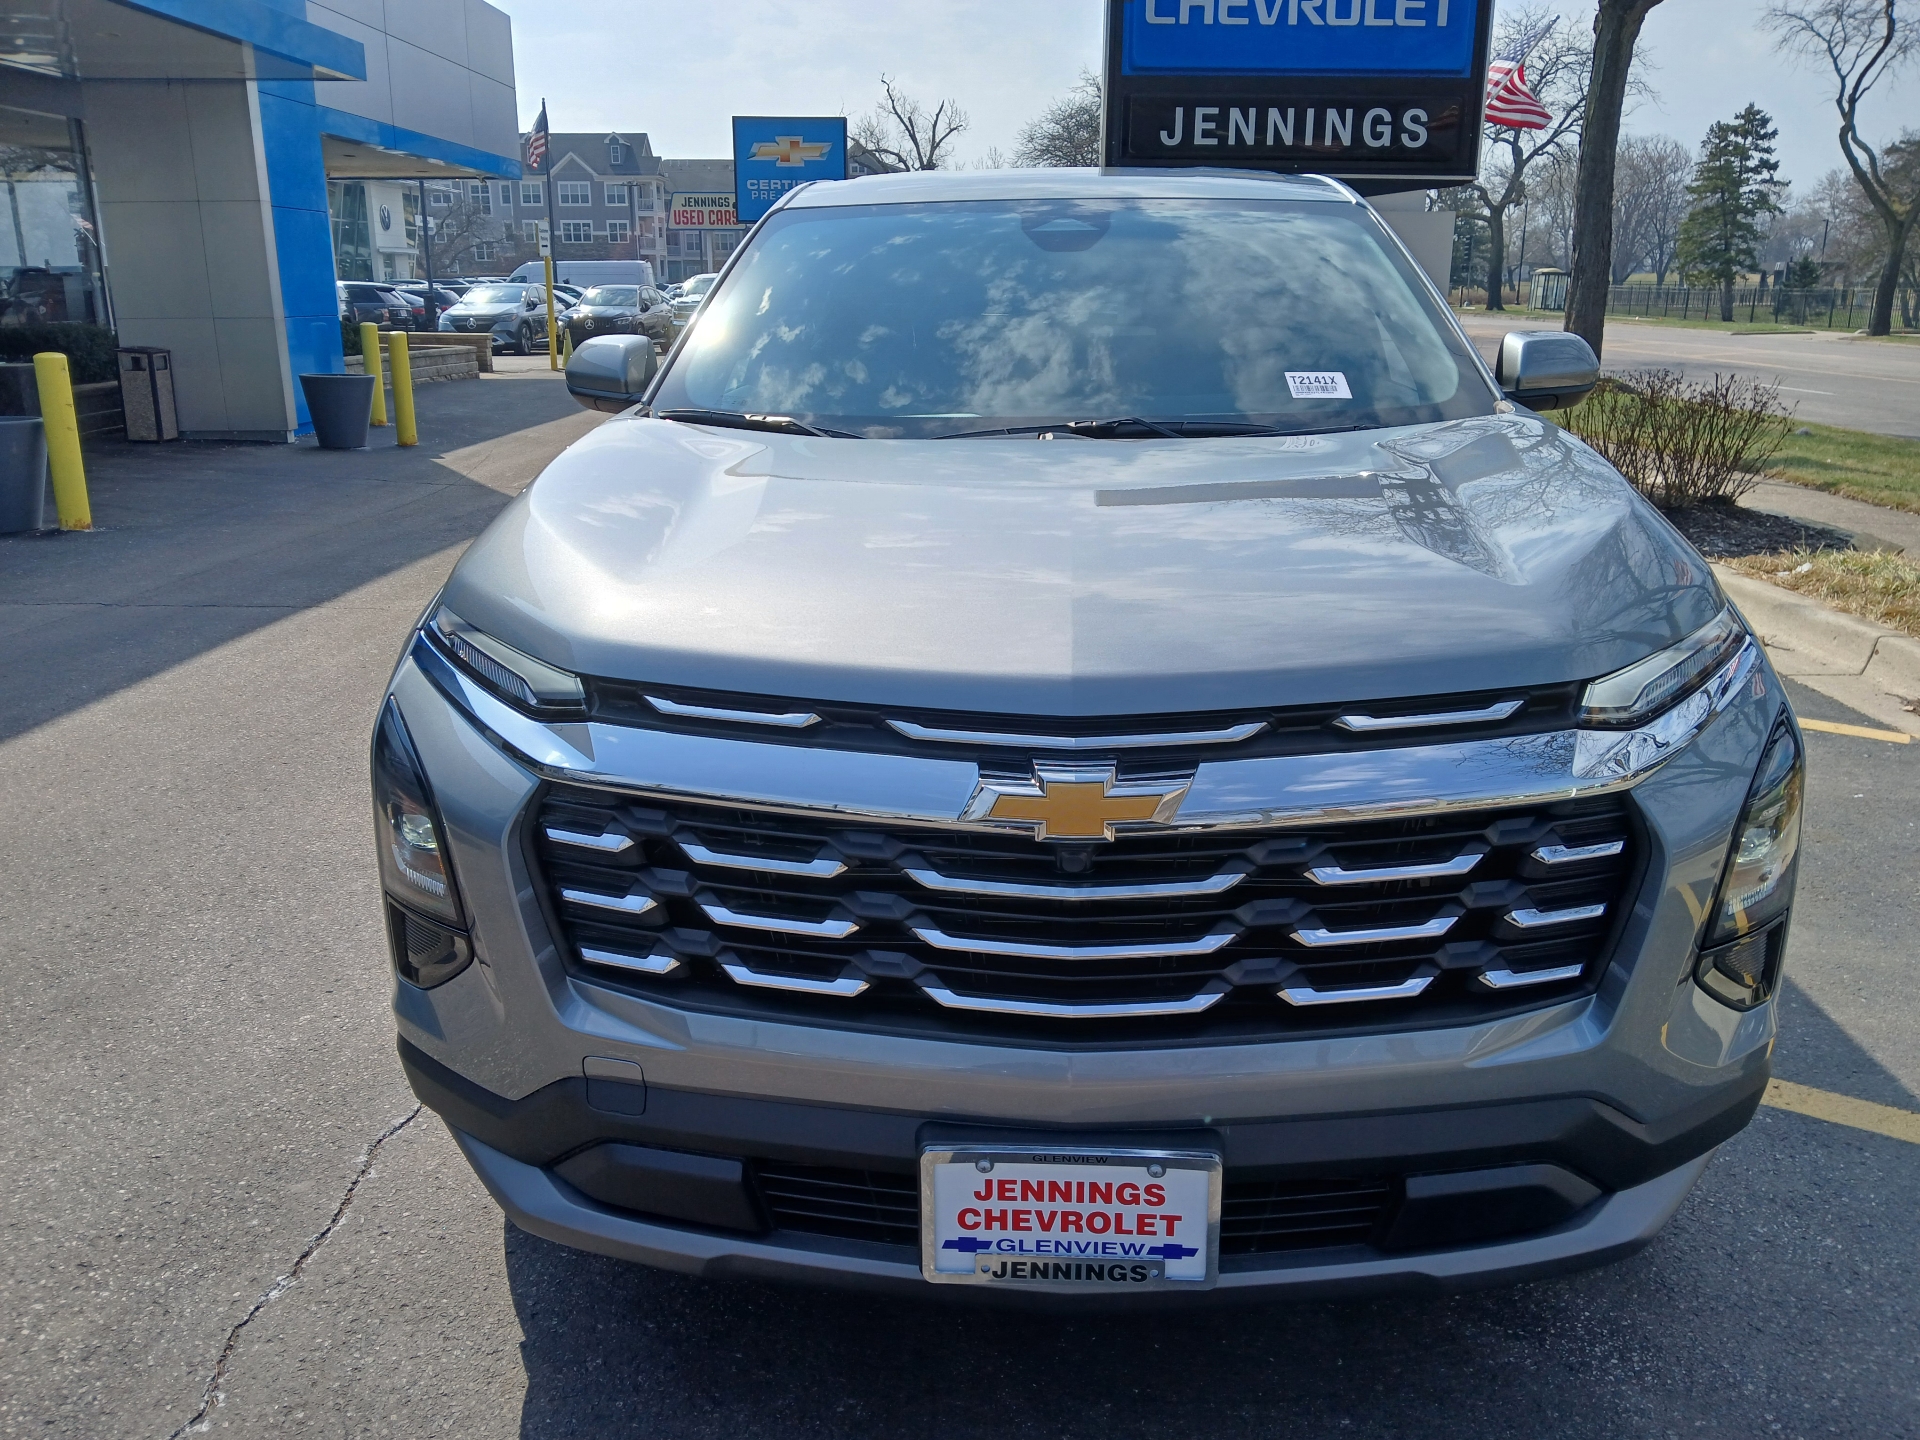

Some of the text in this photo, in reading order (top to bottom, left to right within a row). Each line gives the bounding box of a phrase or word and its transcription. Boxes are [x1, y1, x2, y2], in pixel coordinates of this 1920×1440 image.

[1159, 106, 1429, 148] JENNINGS
[681, 197, 730, 208] JENNINGS
[673, 209, 739, 226] USED CARS
[1289, 375, 1338, 385] T2141X
[1032, 1154, 1109, 1164] GLENVIEW
[973, 1178, 1166, 1207] JENNINGS
[957, 1207, 1182, 1237] CHEVROLET
[995, 1238, 1146, 1256] GLENVIEW
[992, 1261, 1148, 1282] JENNINGS
